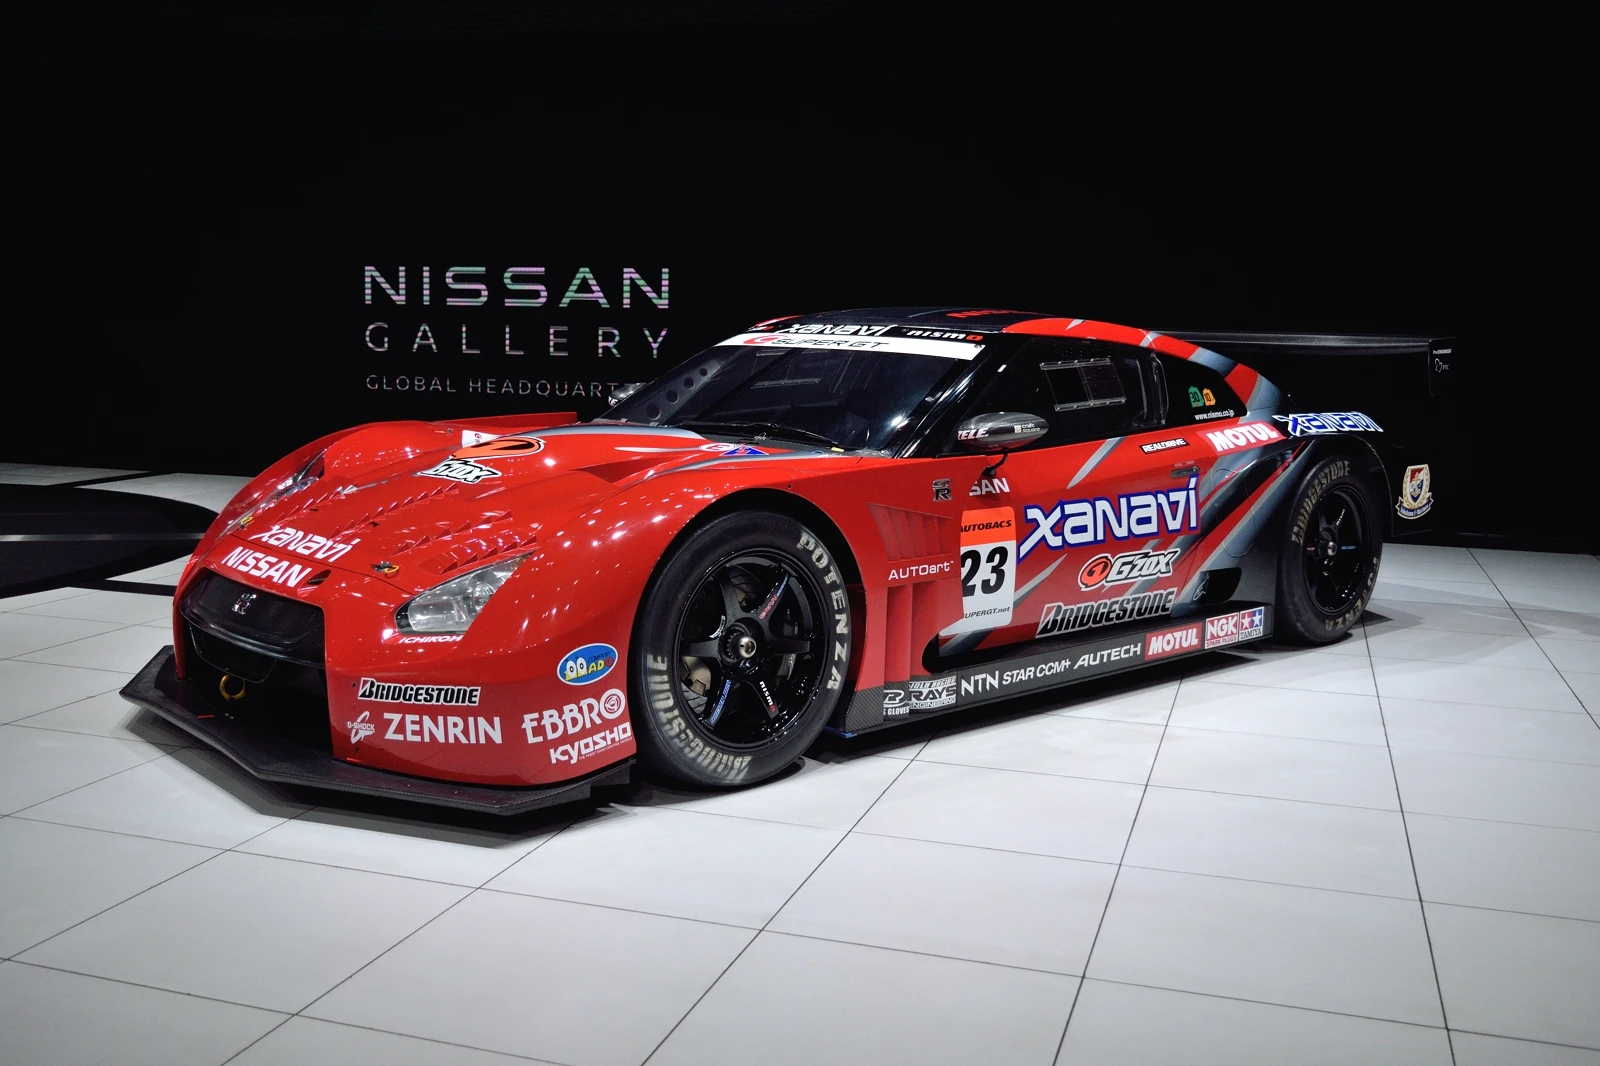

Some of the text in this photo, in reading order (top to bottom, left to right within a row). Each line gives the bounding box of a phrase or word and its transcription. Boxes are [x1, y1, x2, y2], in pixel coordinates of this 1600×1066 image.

[365, 266, 669, 308] NISSAN
[365, 322, 668, 358] GALLERY
[906, 330, 983, 341] nismo
[366, 375, 619, 398] GLOBAL HEADQUART
[1142, 438, 1186, 453] REALDRIVE
[1206, 423, 1279, 452] MOTUL
[221, 546, 312, 588] NISSAN
[888, 562, 950, 580] AUTOart
[960, 546, 1008, 597] 23
[797, 531, 849, 690] POTENZA
[963, 607, 1010, 619] UPERGT.net
[1037, 589, 1176, 636] BRIDGESTONE
[399, 634, 463, 644] ICHIKOH
[1207, 615, 1238, 640] NGK
[1240, 627, 1262, 639] TAMIYA
[1148, 628, 1198, 655] MOTUL
[1206, 635, 1237, 648] SPARK PLUGS
[1073, 642, 1142, 670] AUTECH
[961, 658, 1071, 696] NTN STAR CCM+
[359, 679, 480, 704] BRIDGESTONE
[760, 680, 776, 713] nismo
[910, 685, 957, 702] RAYS
[522, 688, 626, 744] EBBRO
[888, 706, 909, 715] GLOVES
[383, 712, 503, 744] ZENRIN
[549, 721, 632, 765] KYOSHO
